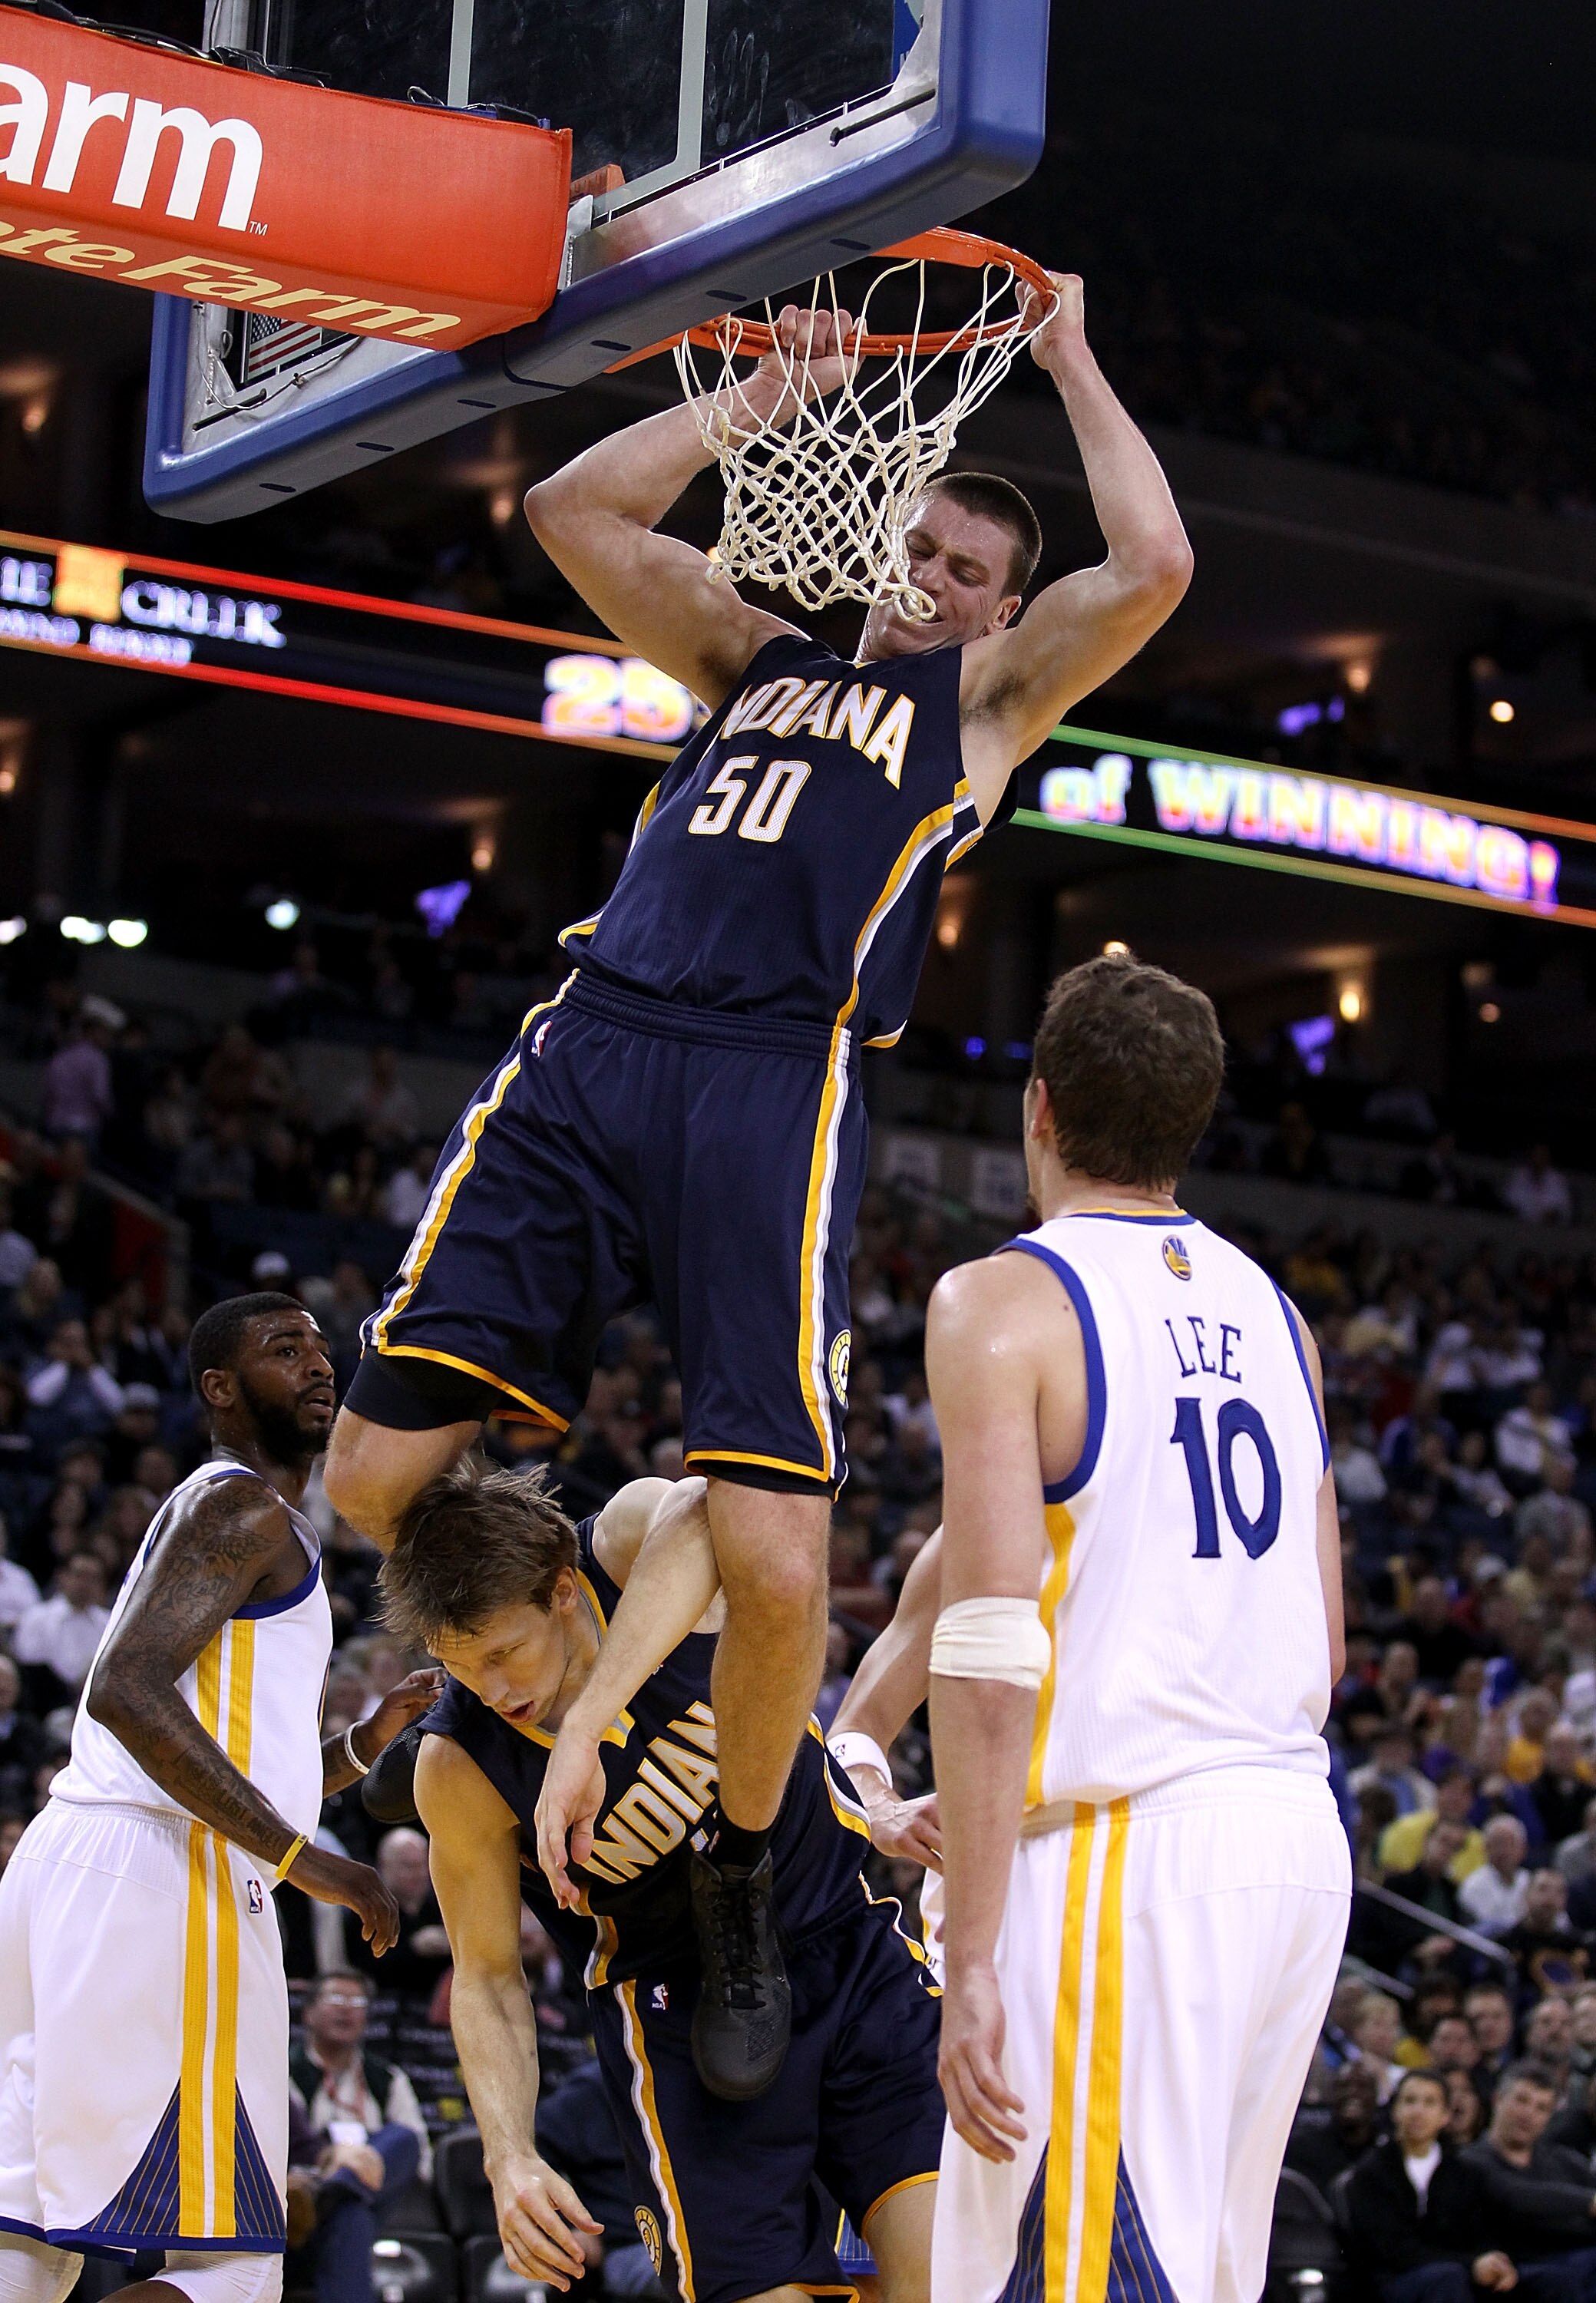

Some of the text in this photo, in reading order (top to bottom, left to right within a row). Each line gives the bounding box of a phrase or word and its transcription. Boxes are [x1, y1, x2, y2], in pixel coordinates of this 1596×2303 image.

[0, 62, 263, 232] arm
[0, 220, 461, 338] te Farm
[688, 755, 811, 843] 50
[720, 677, 915, 790] NDIANA
[1040, 754, 1561, 916] of WINNING!
[1165, 1316, 1242, 1383] LEE
[1170, 1397, 1282, 1560] 10
[581, 1700, 719, 1885] INDIAN
